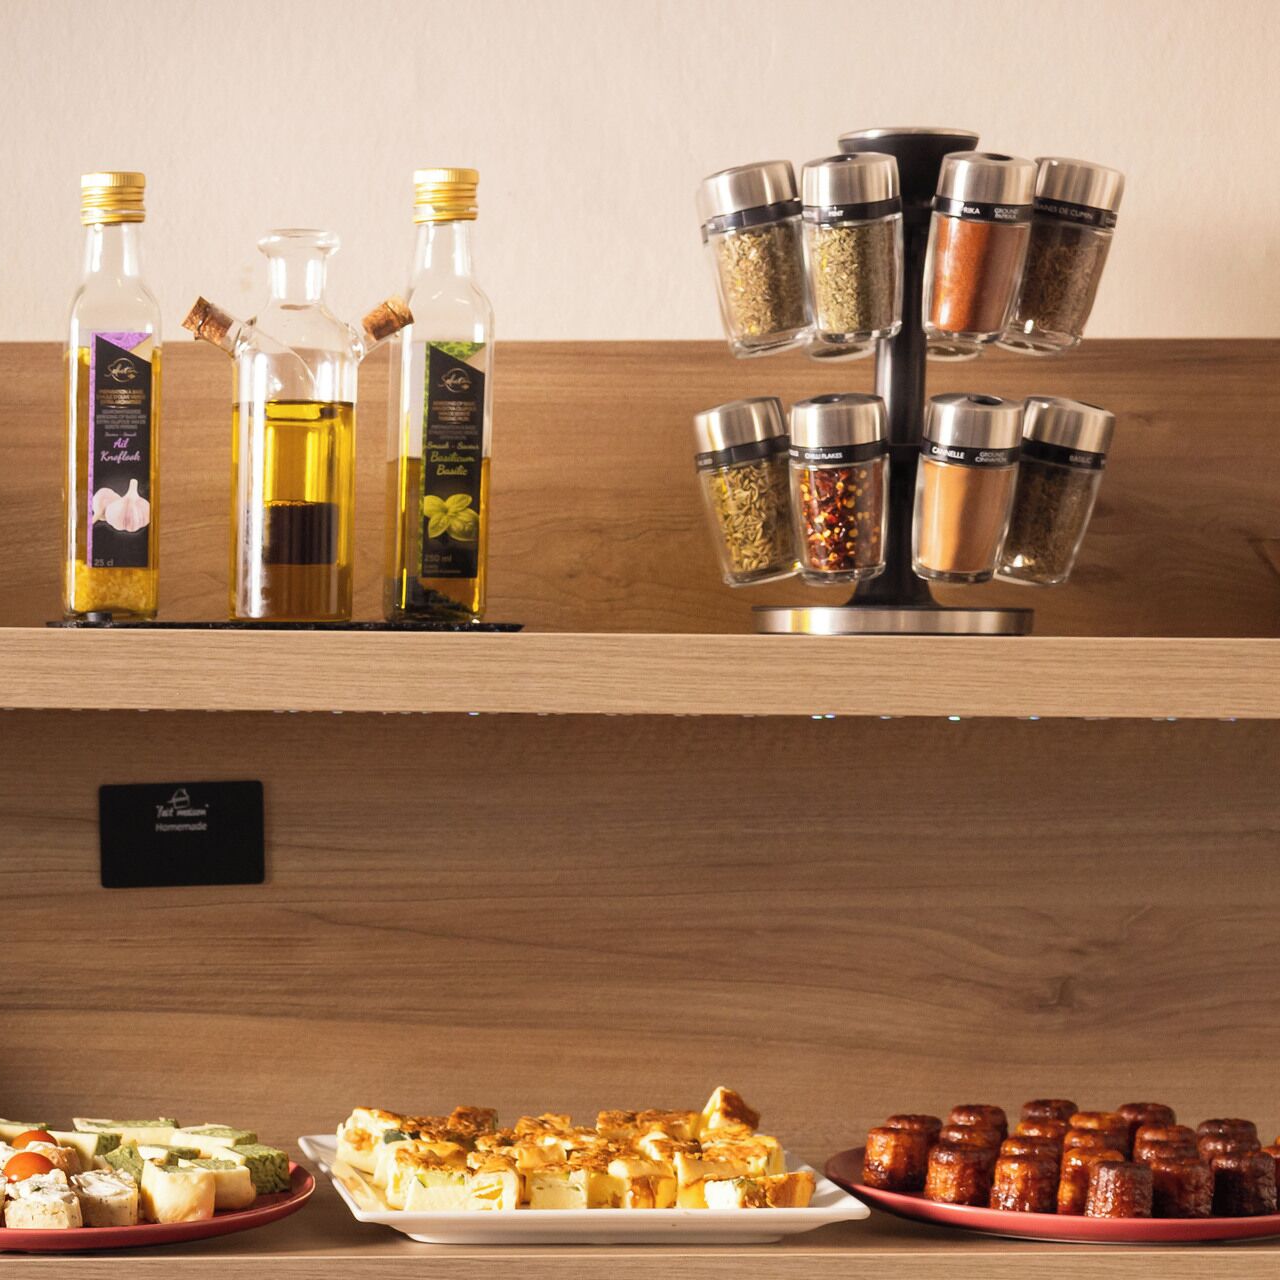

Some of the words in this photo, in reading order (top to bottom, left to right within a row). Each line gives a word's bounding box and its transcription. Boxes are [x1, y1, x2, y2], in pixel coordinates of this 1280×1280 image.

[113, 437, 130, 449] Ail
[931, 446, 965, 460] CANNELLE
[155, 822, 208, 832] Homemade
